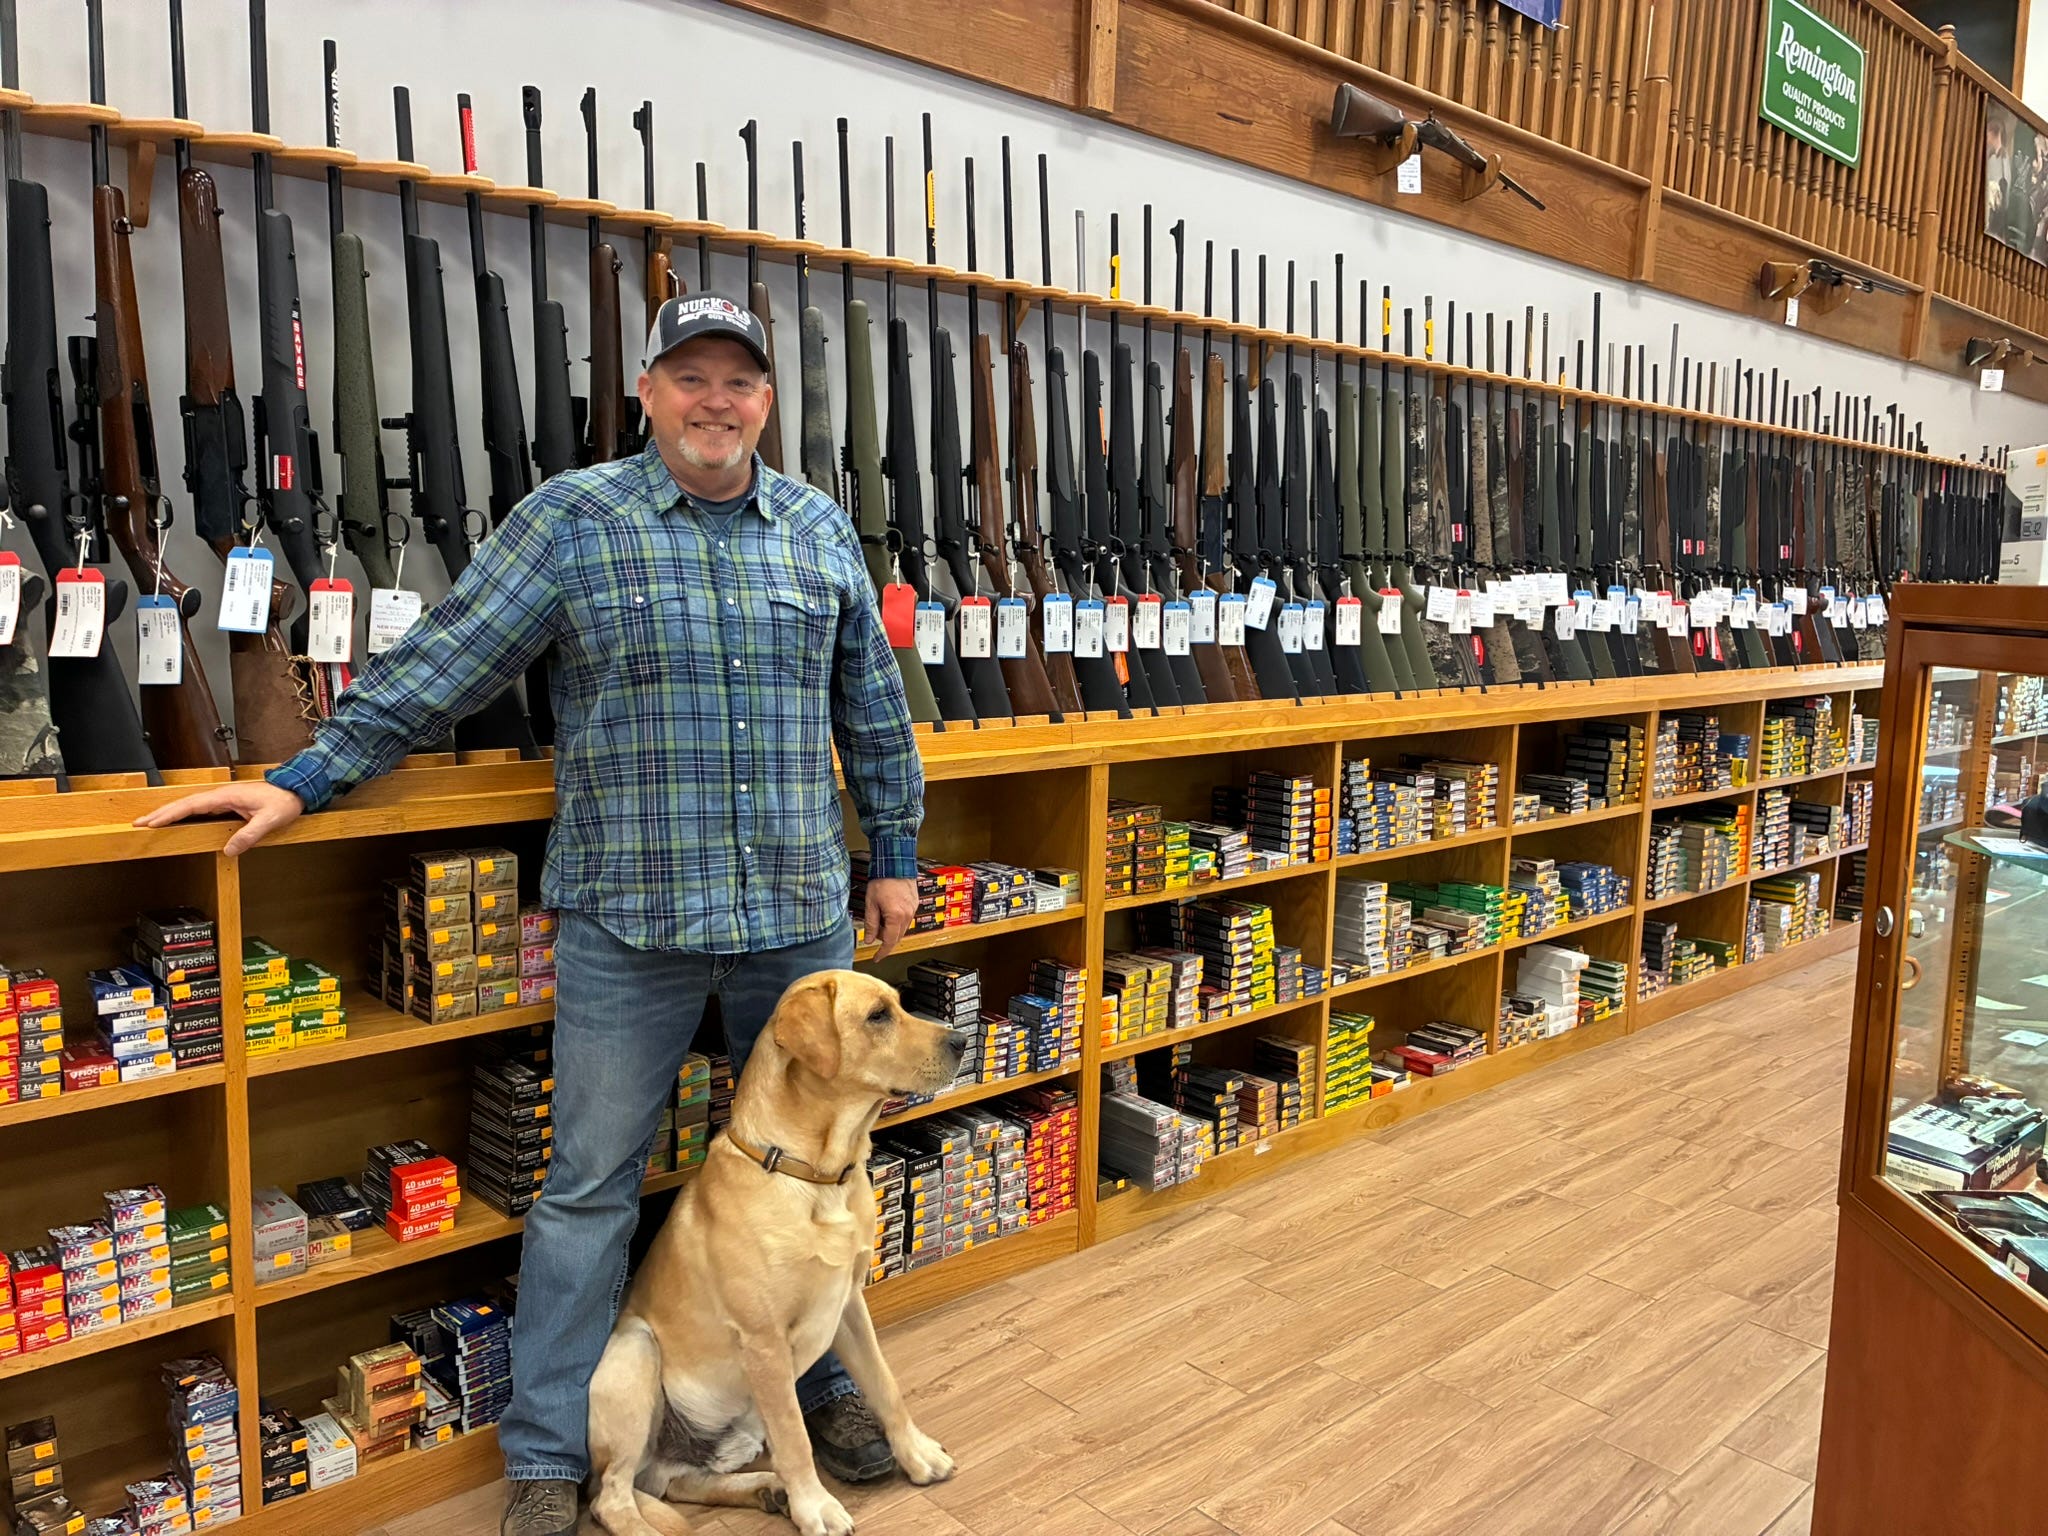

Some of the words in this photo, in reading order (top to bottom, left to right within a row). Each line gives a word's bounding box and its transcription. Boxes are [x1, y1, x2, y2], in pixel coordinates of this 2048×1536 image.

[1775, 21, 1856, 104] Remington
[1782, 81, 1812, 109] QUALITY
[1812, 99, 1846, 130] PRODUCTS
[1794, 105, 1813, 127] SOLD
[1812, 116, 1829, 137] HERE
[678, 297, 751, 326] NUCKOLS
[292, 320, 304, 389] SAVAGE
[174, 929, 211, 940] FIOCCHI
[178, 955, 215, 966] FIOCCHI
[249, 973, 268, 981] SPECIAL
[104, 991, 132, 1000] MAGT
[191, 987, 220, 997] OCCHI
[119, 1011, 146, 1019] MAGT
[252, 1006, 272, 1014] SPECIAL
[184, 1017, 219, 1028] FIOCCHI
[310, 1028, 329, 1036] SPECIAL
[120, 1034, 147, 1042] MAGT
[252, 1039, 272, 1047] SPECIAL
[187, 1043, 222, 1054] FIOCCHI
[127, 1058, 154, 1066] MAGT
[78, 1065, 114, 1077] FIOCCHI
[914, 1160, 938, 1171] NOSLER
[1990, 1161, 2018, 1190] Revolver
[405, 1181, 416, 1190] 40
[417, 1179, 432, 1187] S&W
[410, 1204, 420, 1213] 40
[421, 1202, 436, 1210] S&W
[403, 1226, 414, 1234] 40
[414, 1223, 429, 1231] S&W
